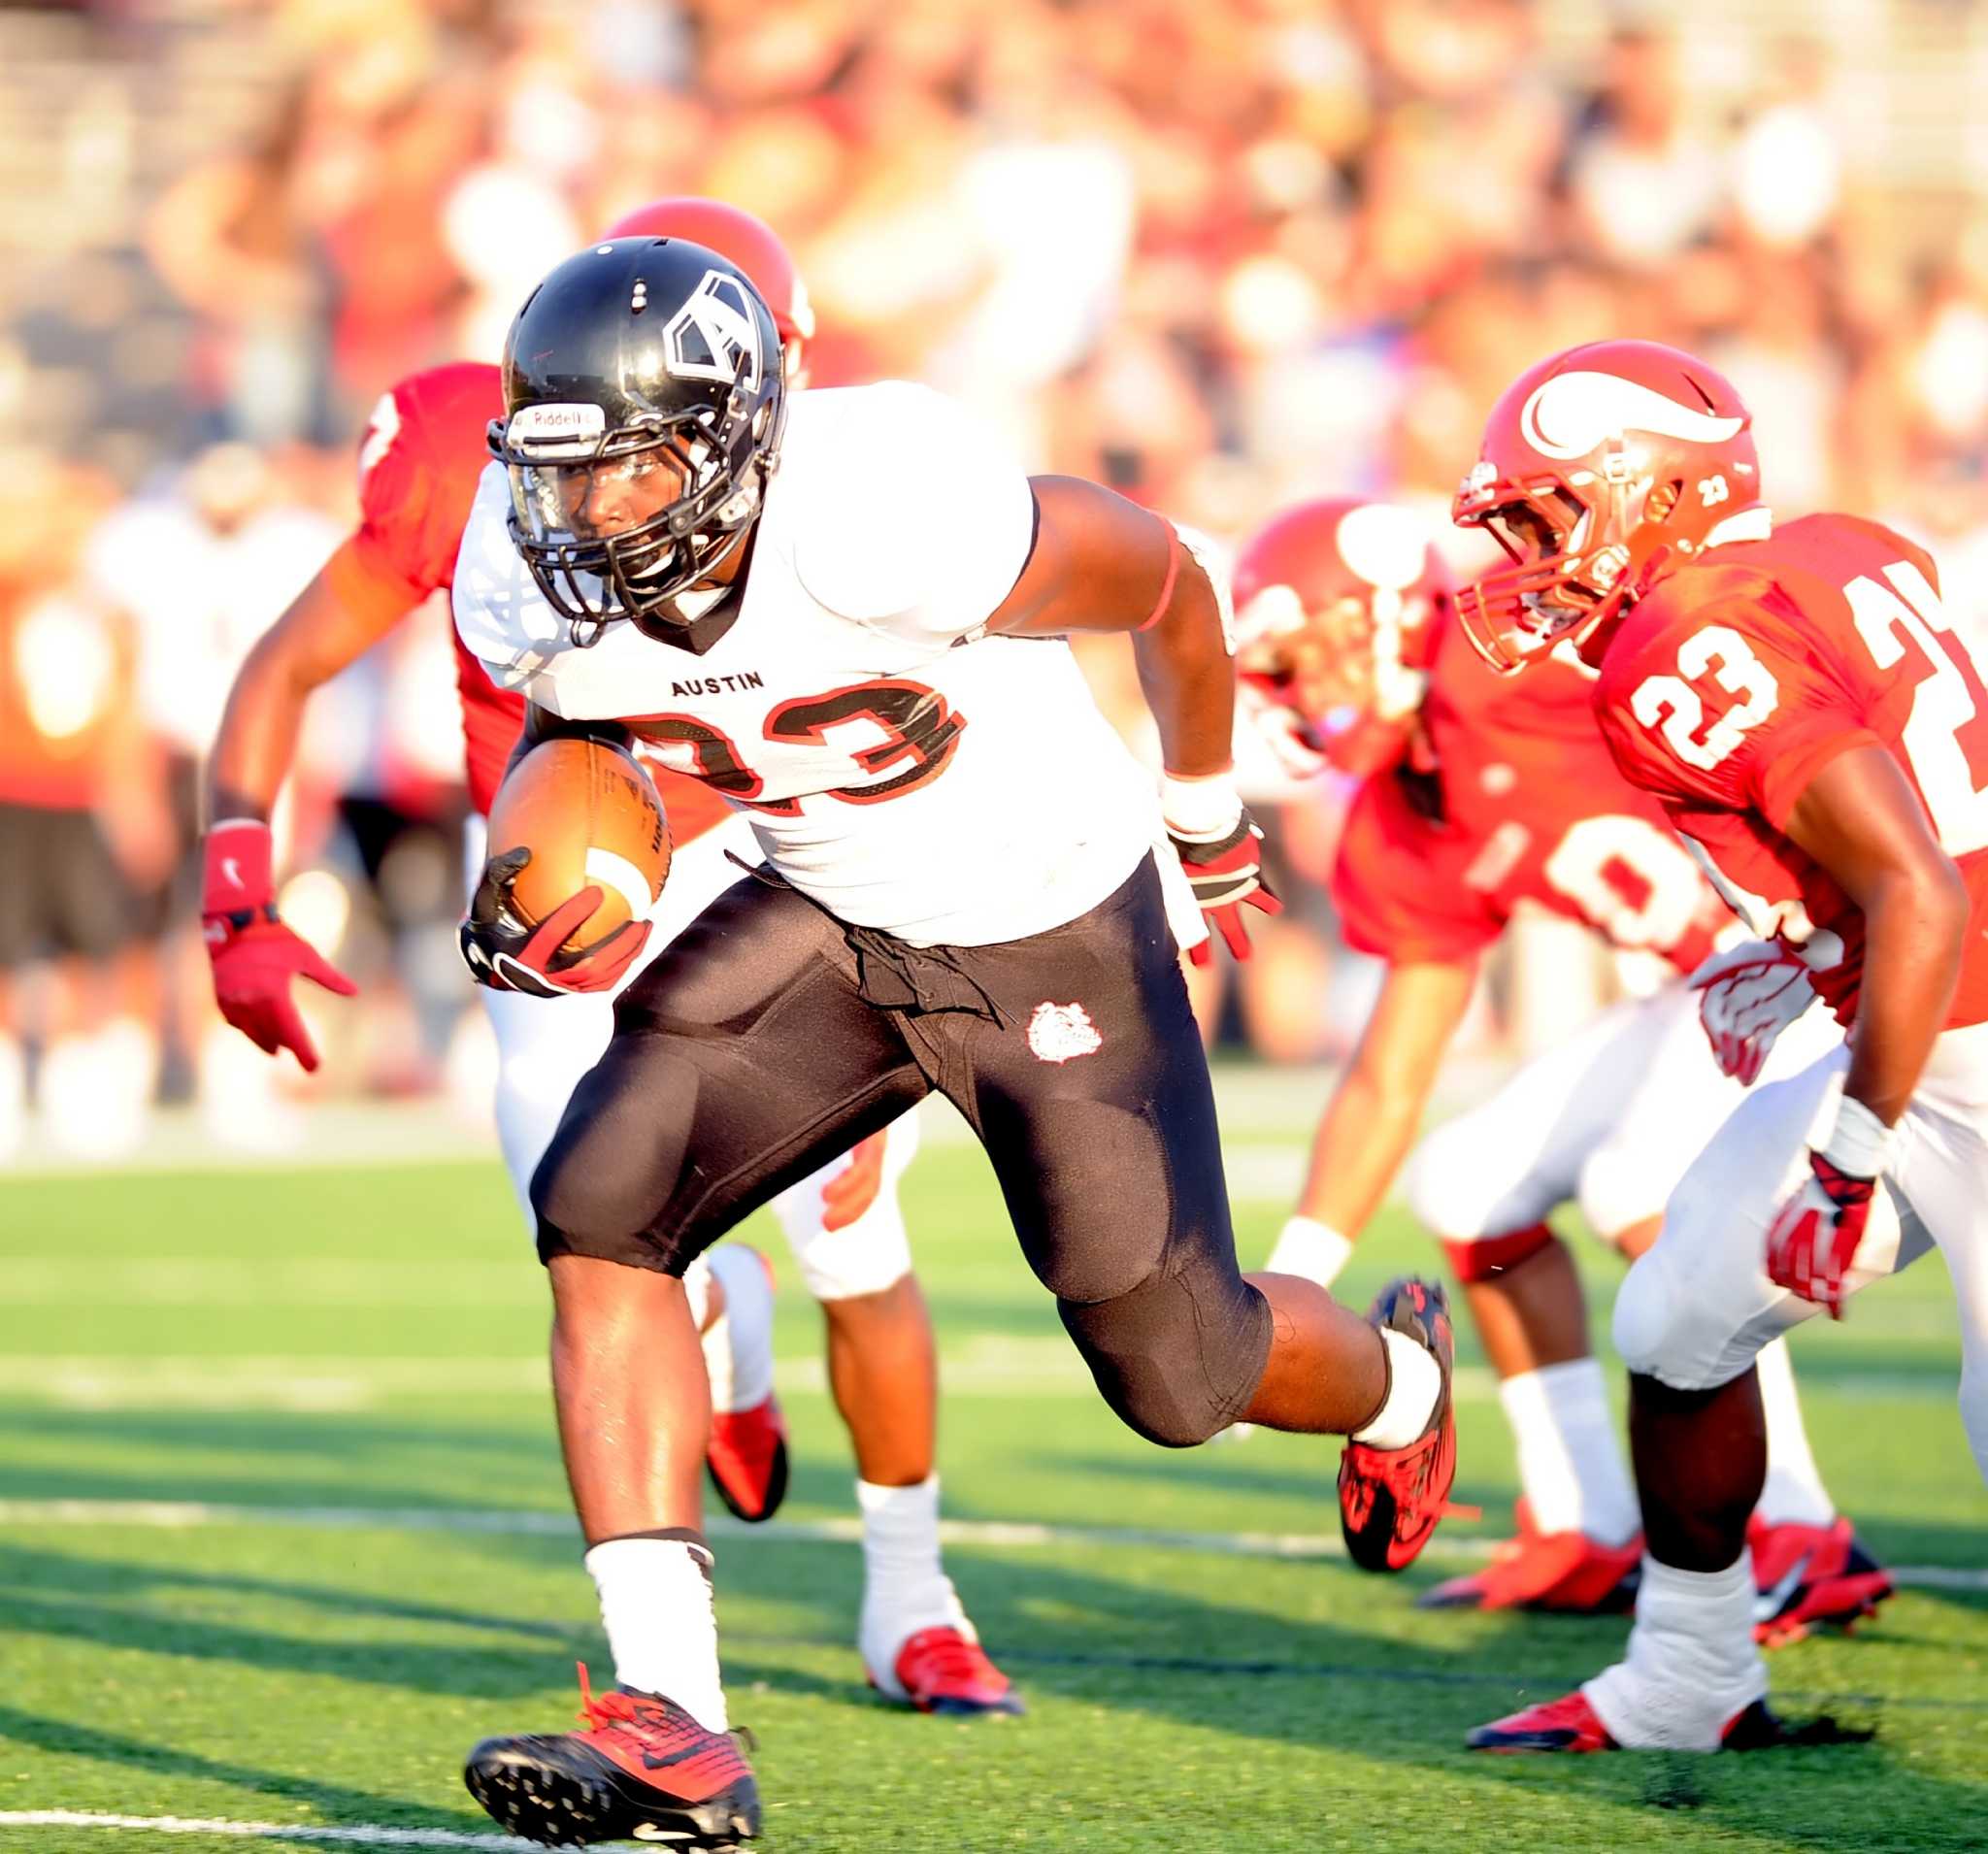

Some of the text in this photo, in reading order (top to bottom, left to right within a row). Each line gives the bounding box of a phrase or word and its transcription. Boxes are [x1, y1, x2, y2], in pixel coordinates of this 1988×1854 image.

[534, 412, 581, 427] Riddell
[672, 671, 765, 698] AUSTIN
[1630, 625, 1778, 771] 23
